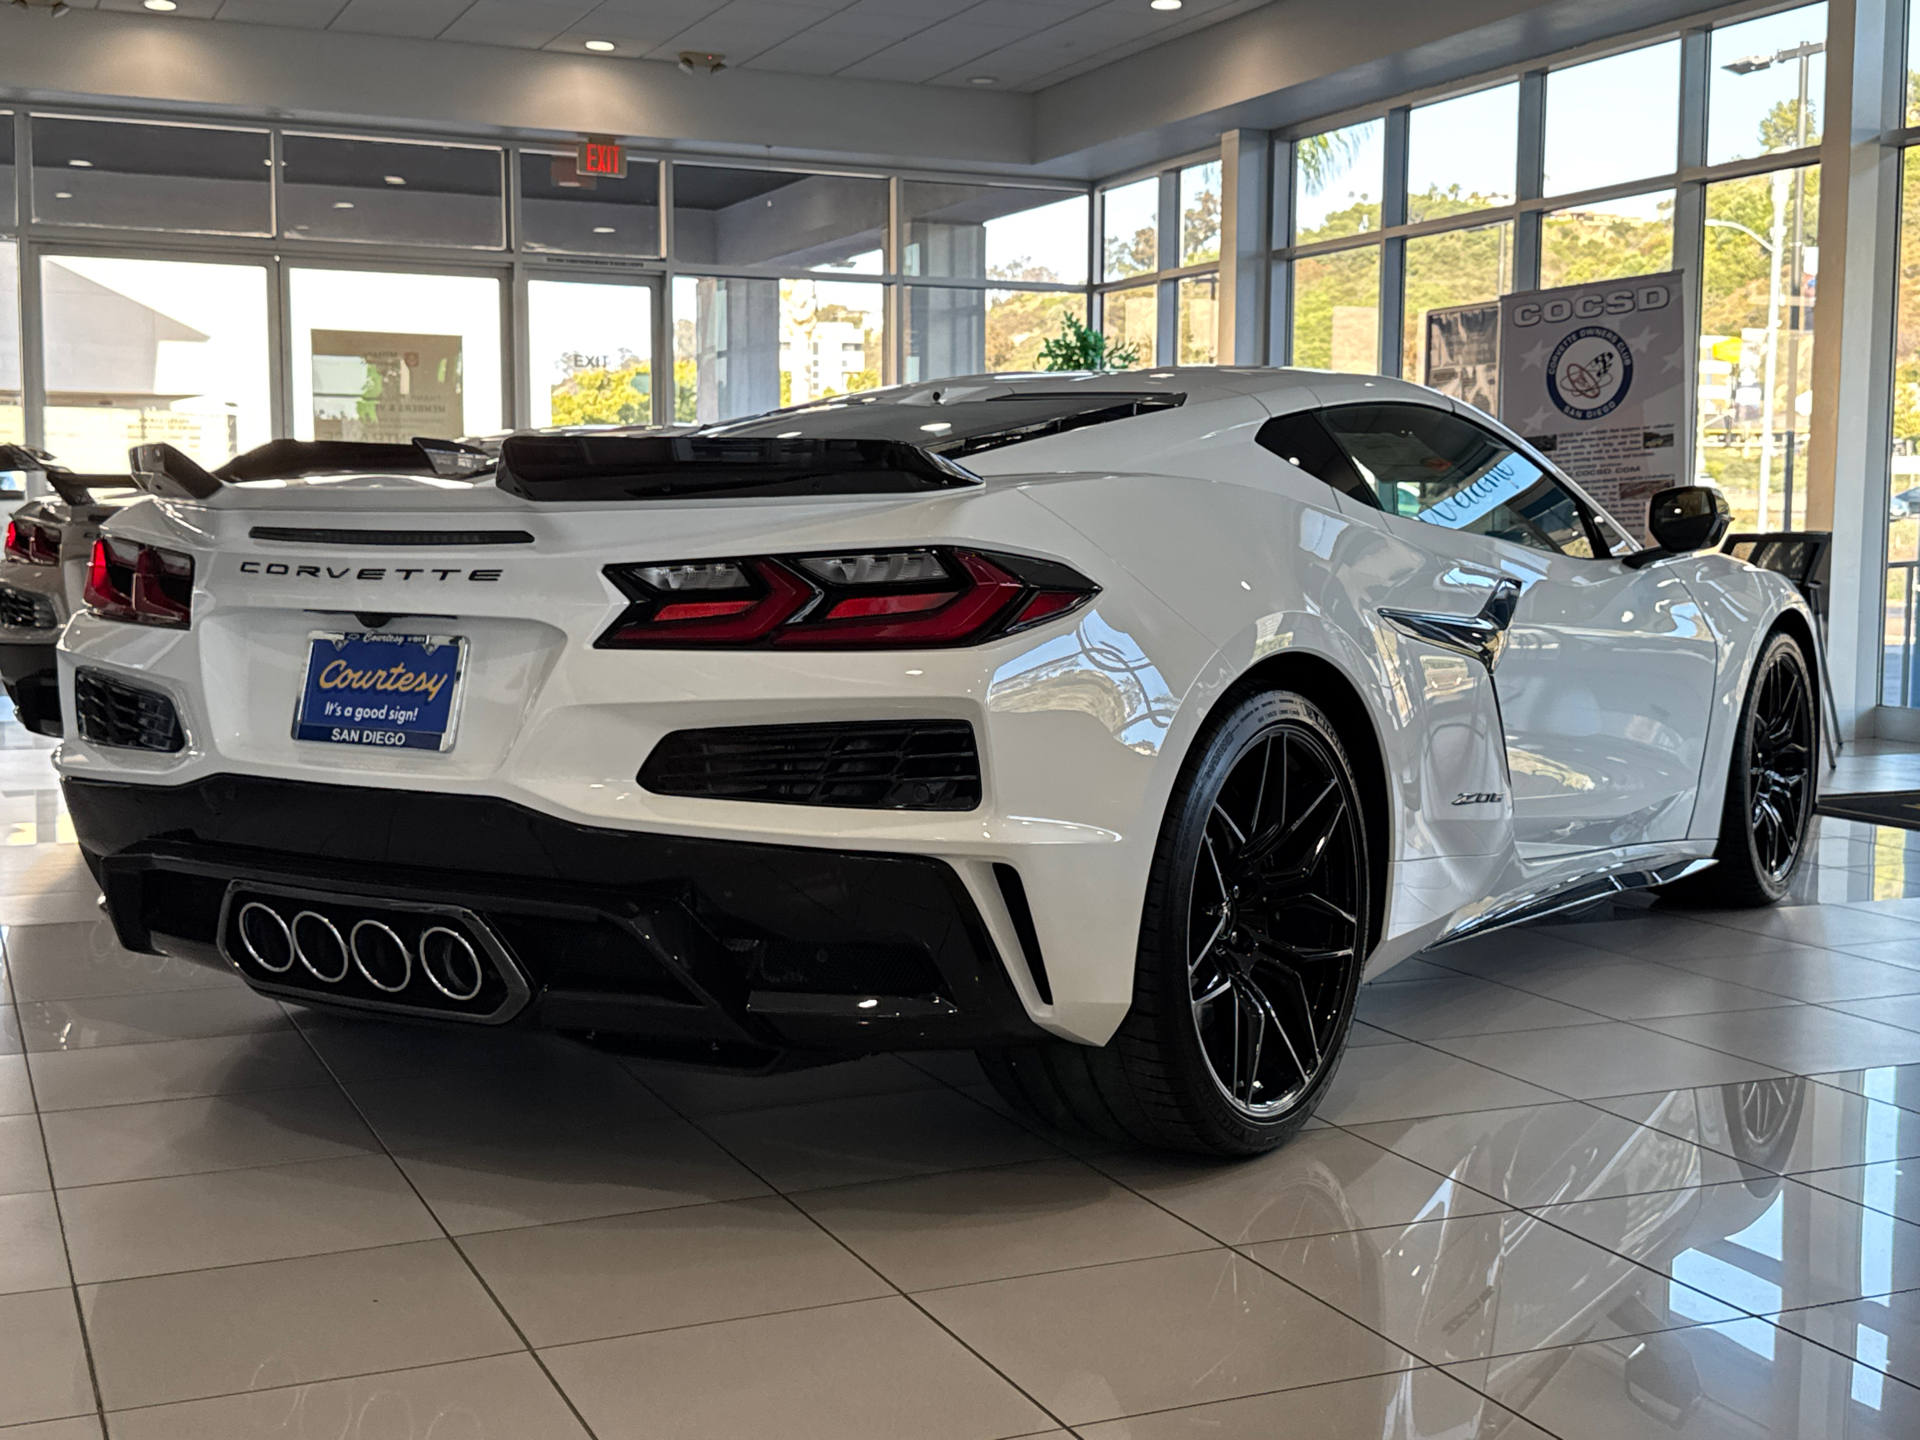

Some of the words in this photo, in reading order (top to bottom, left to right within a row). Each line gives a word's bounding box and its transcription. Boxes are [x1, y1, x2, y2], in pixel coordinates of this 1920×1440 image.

[586, 143, 621, 173] EXIT
[1513, 286, 1670, 328] COCSD
[573, 354, 609, 368] EXIT
[1548, 333, 1577, 375] CORVETTE
[1579, 329, 1618, 343] OWNERS
[1616, 341, 1632, 366] CLUB
[1563, 405, 1582, 418] SAN
[1586, 400, 1616, 418] DIEGO
[1429, 462, 1515, 525] Welcome
[240, 561, 504, 581] CORVETTE
[319, 659, 448, 702] Courtesy
[324, 701, 342, 717] It's
[344, 705, 353, 717] a
[354, 705, 388, 721] good
[388, 706, 419, 723] sign!
[331, 728, 359, 743] SAN
[362, 731, 406, 746] DIEGO
